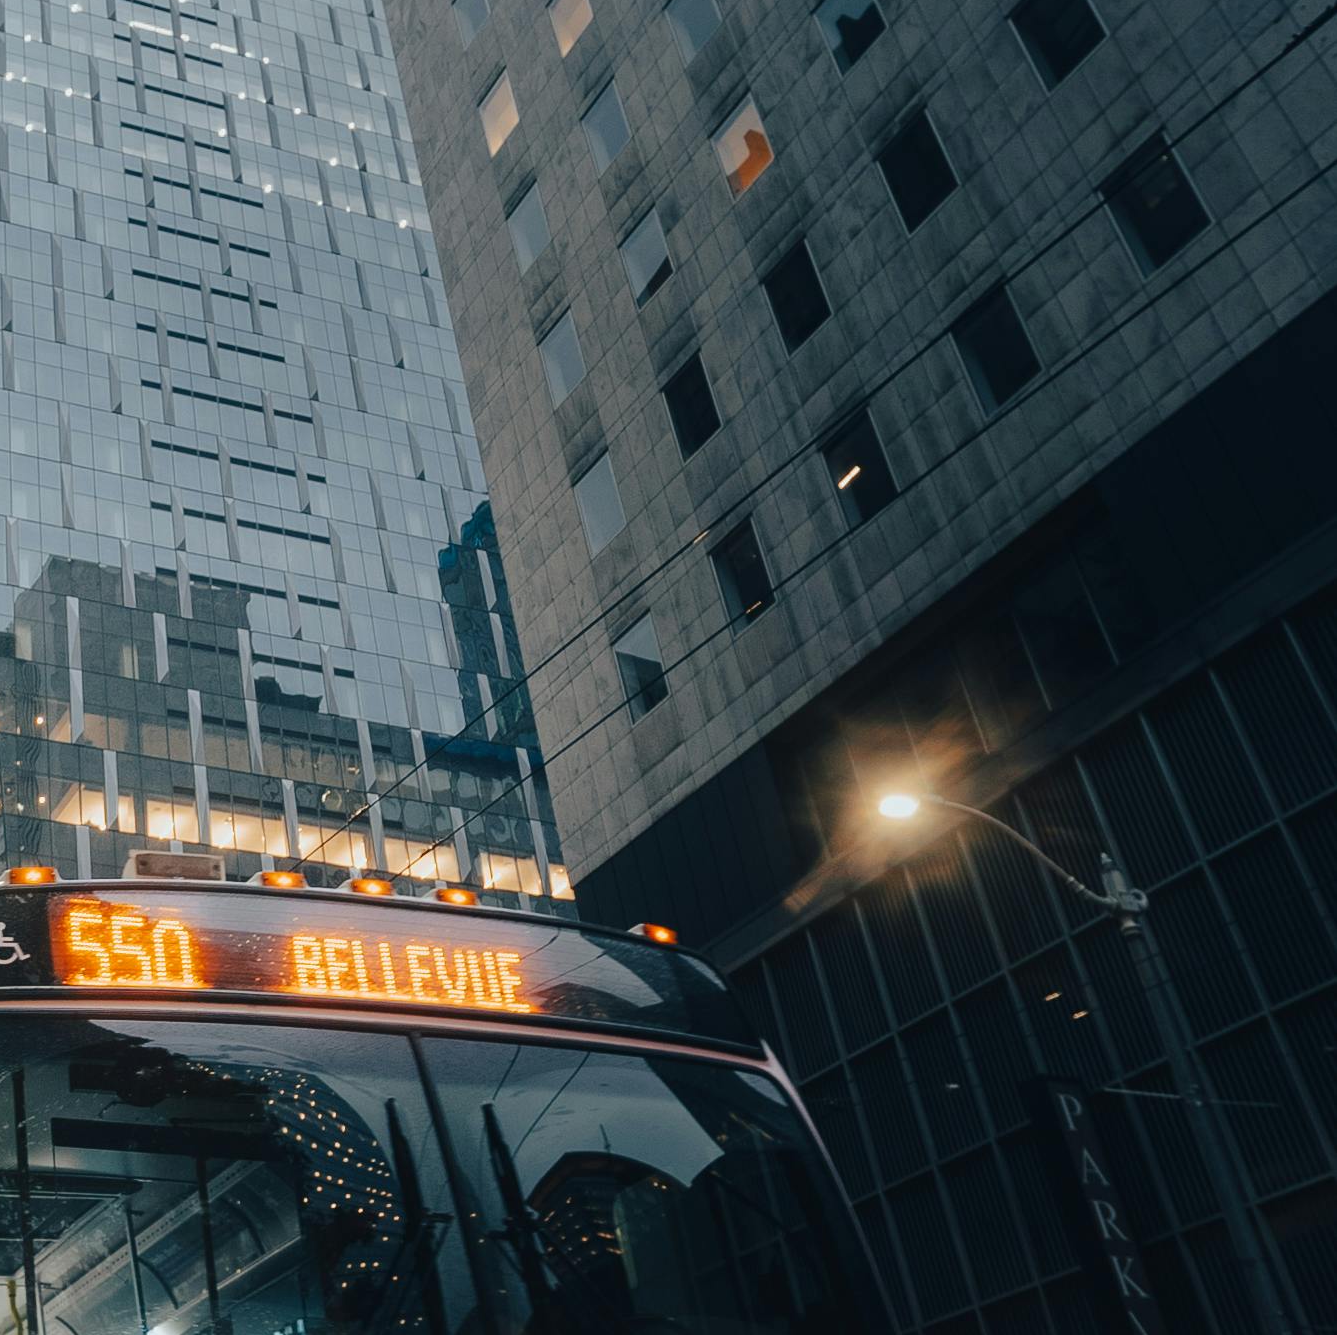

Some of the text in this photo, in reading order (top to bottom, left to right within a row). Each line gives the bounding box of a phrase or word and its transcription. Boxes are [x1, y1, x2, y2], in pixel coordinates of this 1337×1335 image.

[65, 910, 534, 1012] 550 BELLEVUE
[1056, 1092, 1151, 1299] PARK
